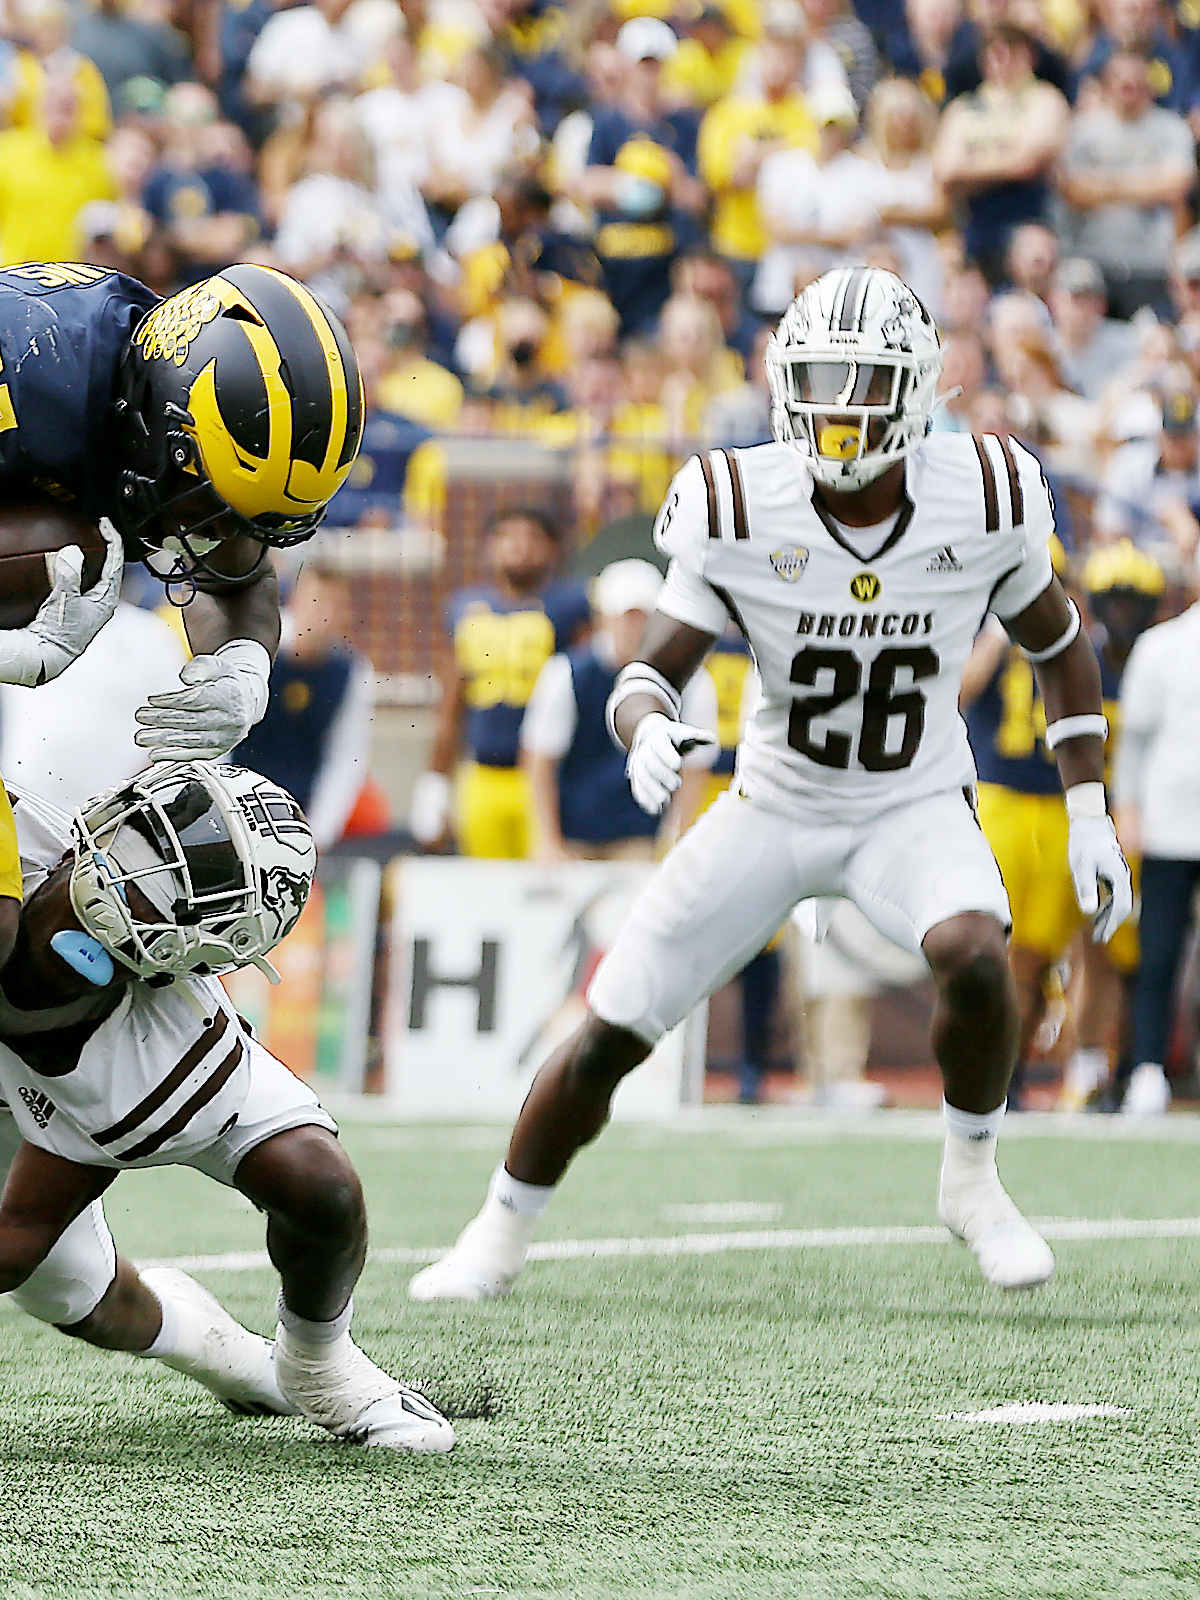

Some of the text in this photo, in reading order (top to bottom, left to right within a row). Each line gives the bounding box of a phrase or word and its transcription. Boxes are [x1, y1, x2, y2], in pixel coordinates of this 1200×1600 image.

[796, 611, 935, 638] BRONCOS
[788, 644, 940, 772] 26
[18, 1087, 48, 1129] adidas
